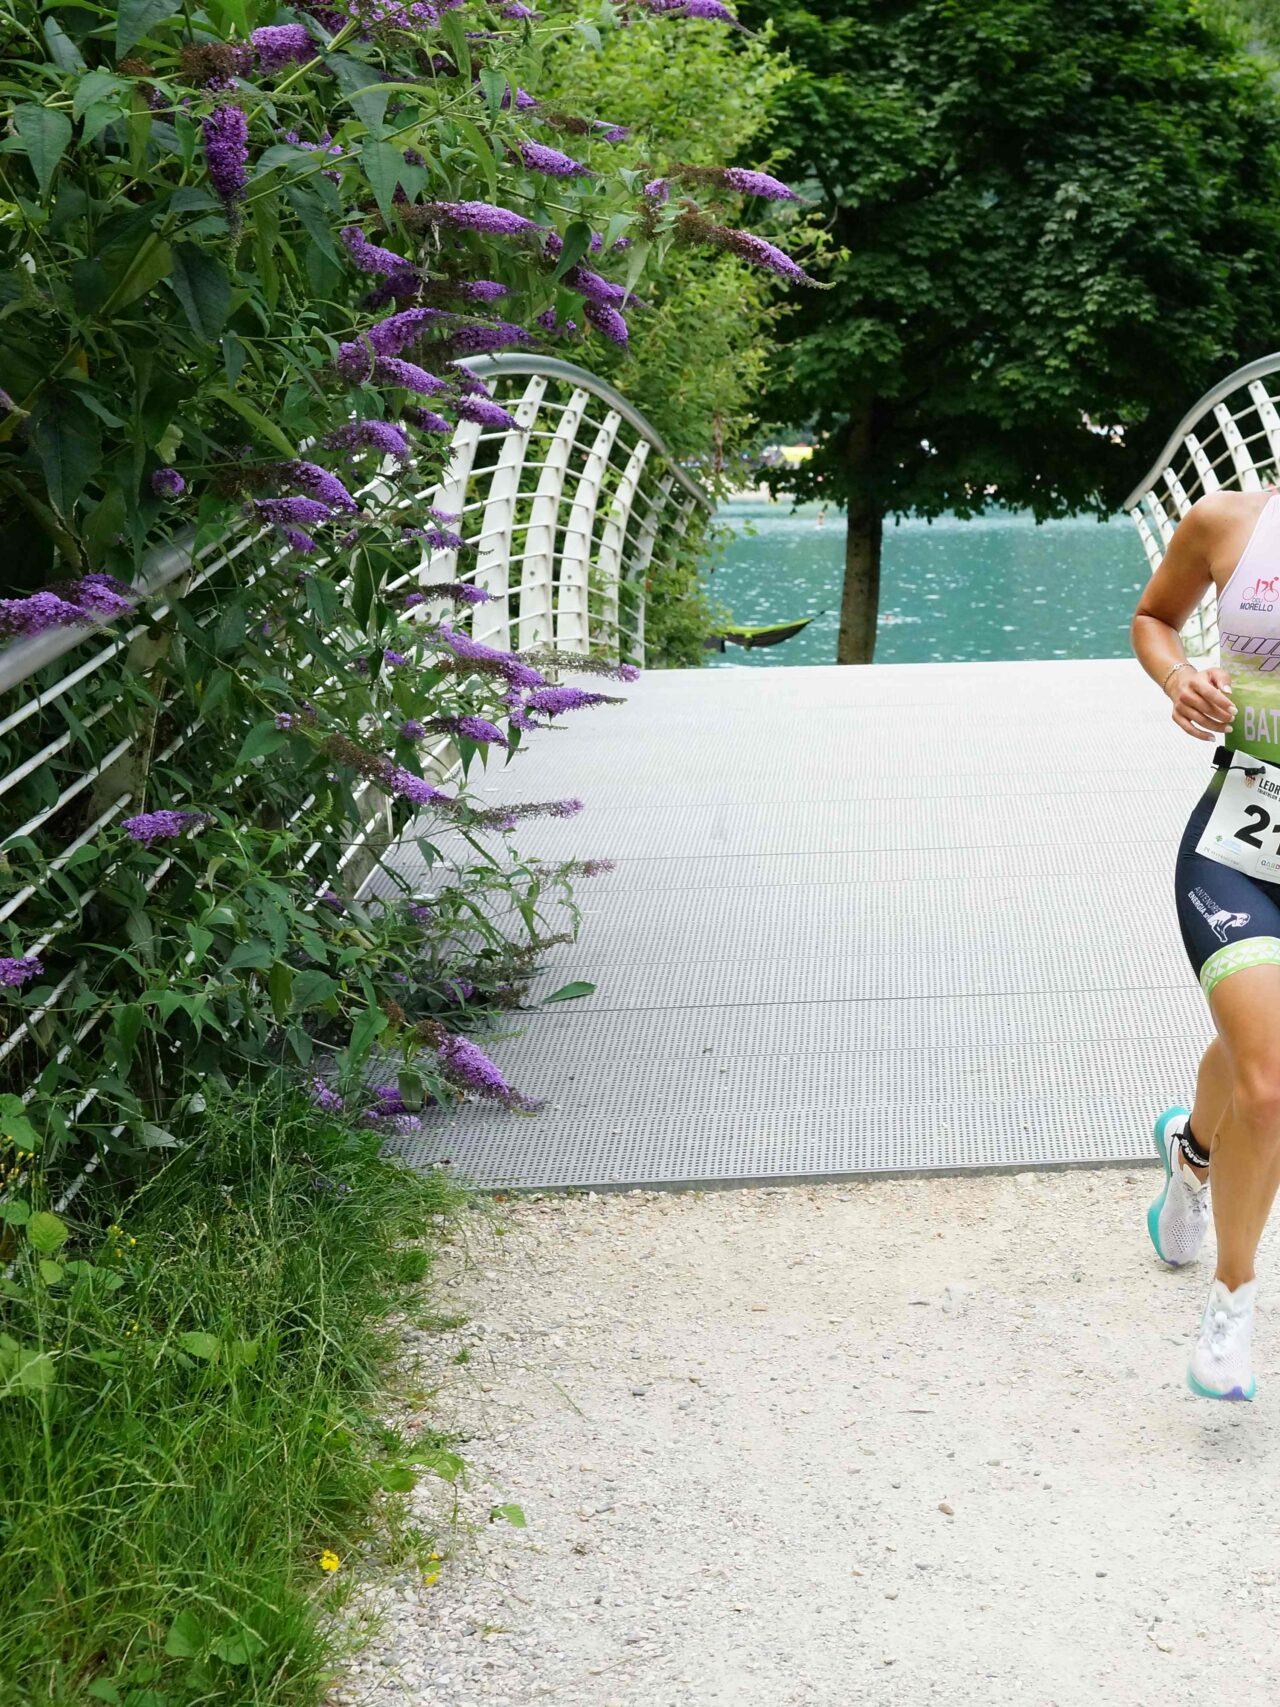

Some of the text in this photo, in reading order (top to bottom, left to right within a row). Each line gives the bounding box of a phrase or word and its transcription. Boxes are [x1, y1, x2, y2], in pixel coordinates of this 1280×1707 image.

[1239, 602, 1274, 613] MORELLO
[1187, 890, 1207, 915] ENERGIA
[1193, 886, 1222, 915] ANTENORE
